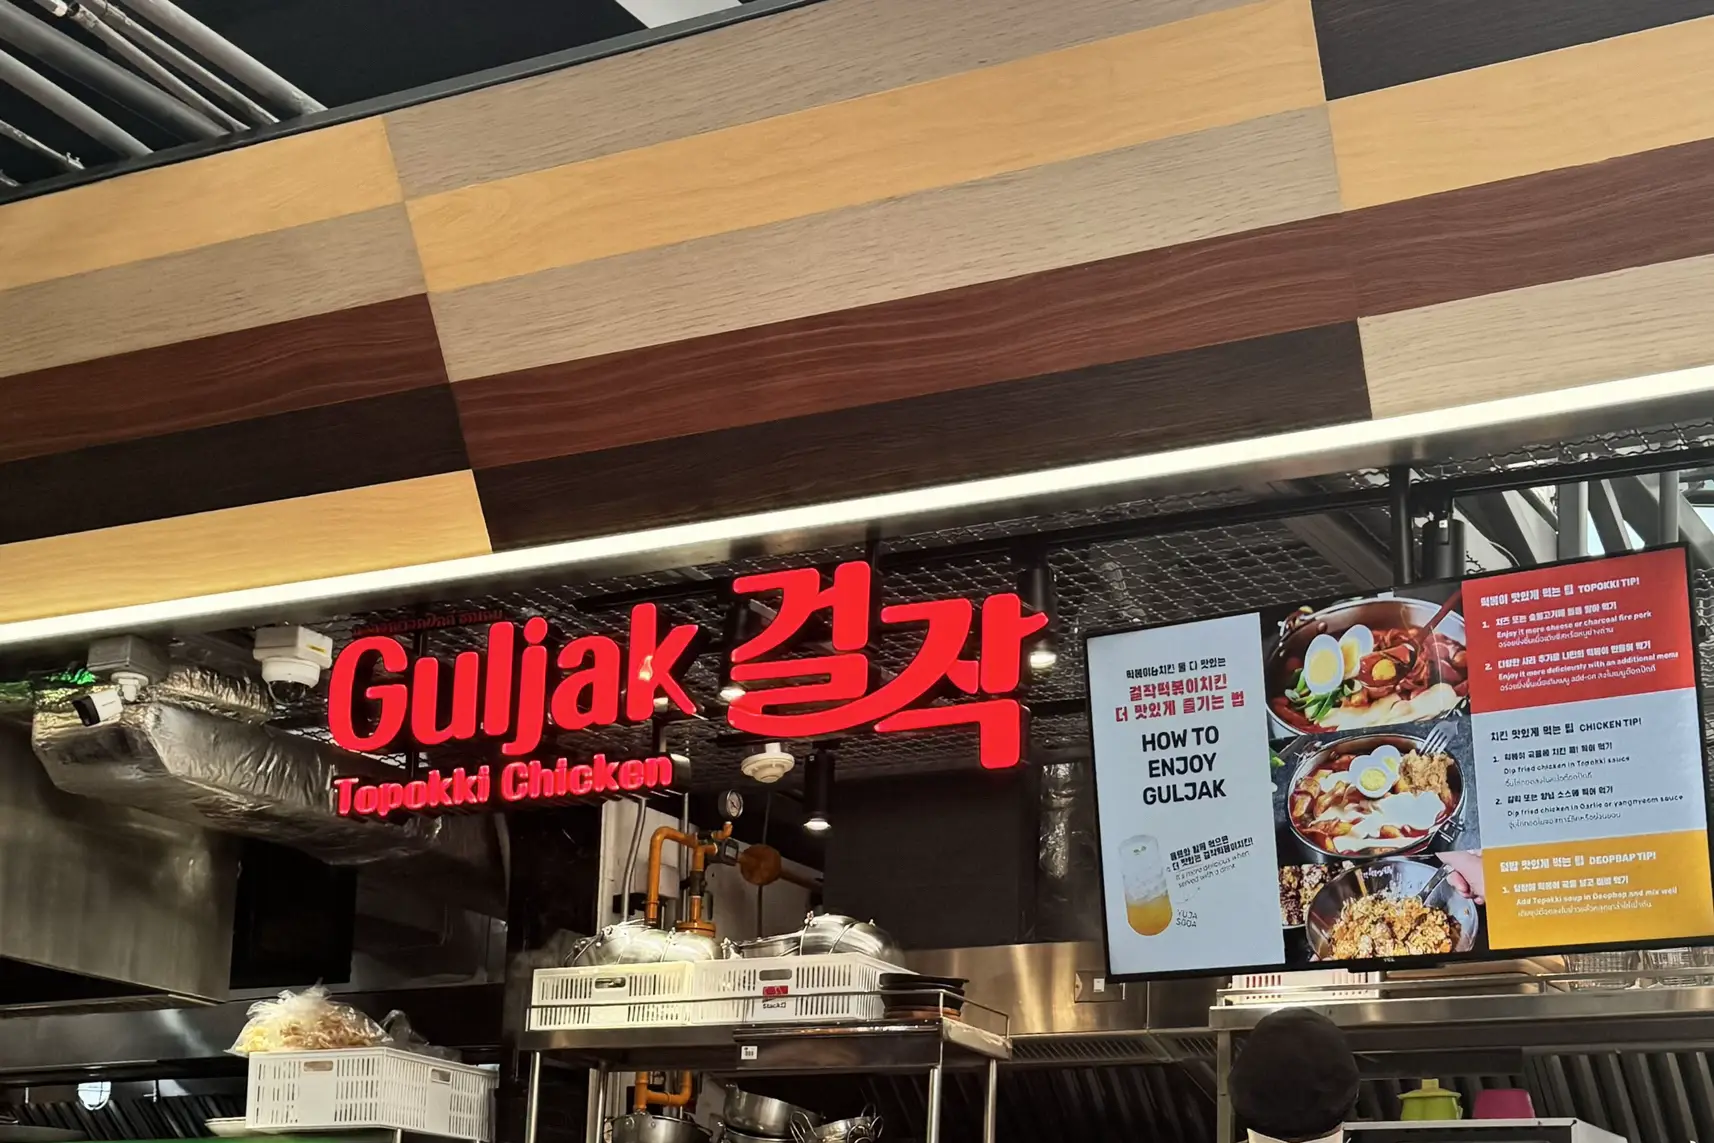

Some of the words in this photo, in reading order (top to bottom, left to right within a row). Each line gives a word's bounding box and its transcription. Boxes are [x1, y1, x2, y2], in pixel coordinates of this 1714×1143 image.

[1578, 581, 1620, 593] TOPOKKI
[1621, 577, 1640, 587] TIP!
[1496, 629, 1517, 639] Enjoy
[1584, 615, 1617, 626] charcoal
[1633, 610, 1652, 621] pork
[727, 561, 1049, 769] 걸작
[1201, 657, 1226, 669] 맛있는
[328, 602, 699, 756] Guljak
[1129, 674, 1228, 702] 걸작떡볶이치킨
[1498, 672, 1519, 681] Enjoy
[1115, 706, 1128, 722] 더
[1134, 700, 1176, 720] 맛있게
[1183, 695, 1225, 714] 즐기는
[1231, 691, 1244, 708] 법
[1142, 729, 1187, 752] HOW
[1191, 725, 1219, 746] TO
[1491, 730, 1508, 741] 치킨
[1512, 727, 1539, 740] 맛있게
[1543, 725, 1561, 736] 먹는
[1580, 719, 1622, 732] CHICKEN
[1623, 717, 1641, 727] TIP!
[1148, 752, 1217, 778] ENJOY
[333, 765, 491, 816] Topokki
[501, 753, 673, 800] Chicken
[1143, 779, 1227, 805] GULJAK
[1589, 853, 1635, 865] DEOPBAP
[1637, 851, 1656, 860] TIP!
[1516, 896, 1531, 906] Add
